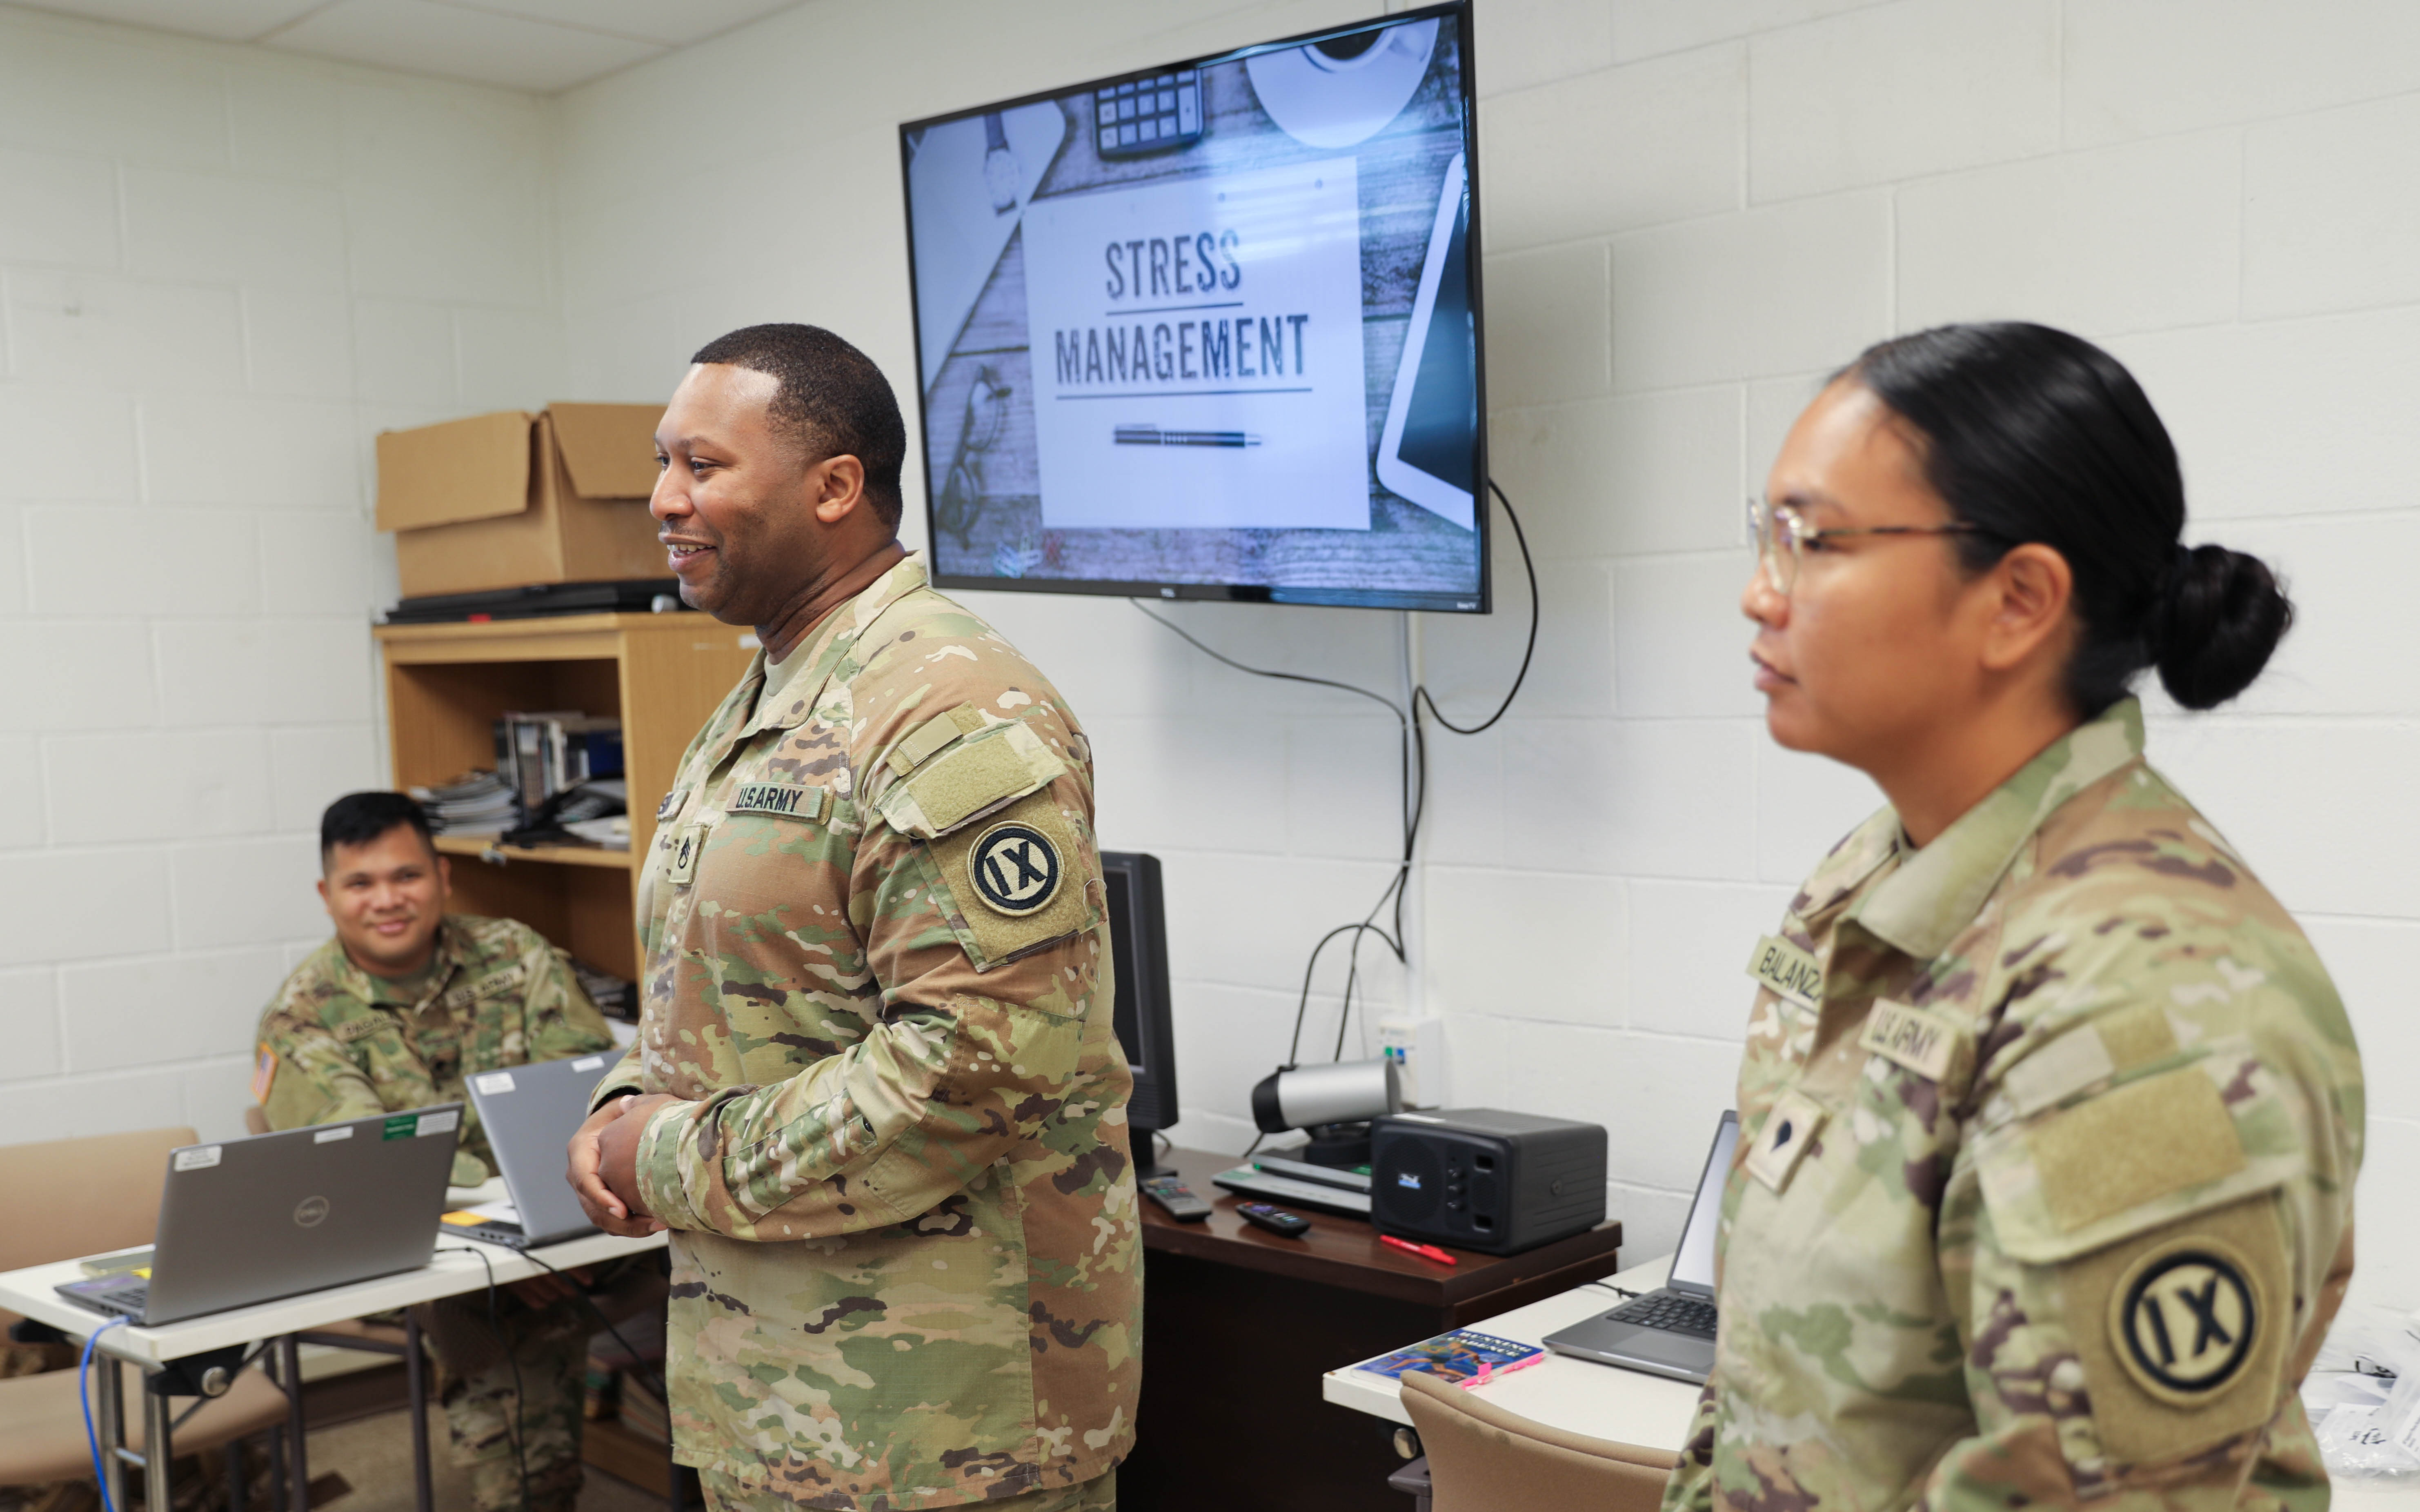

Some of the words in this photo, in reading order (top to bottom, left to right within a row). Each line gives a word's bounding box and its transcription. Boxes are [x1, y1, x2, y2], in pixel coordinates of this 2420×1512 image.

[1106, 229, 1241, 300] STRESS
[1056, 314, 1308, 384] MANAGEMENT
[985, 841, 1048, 897] IX
[1459, 1332, 1532, 1353] RUNNING
[2144, 1274, 2231, 1365] IX
